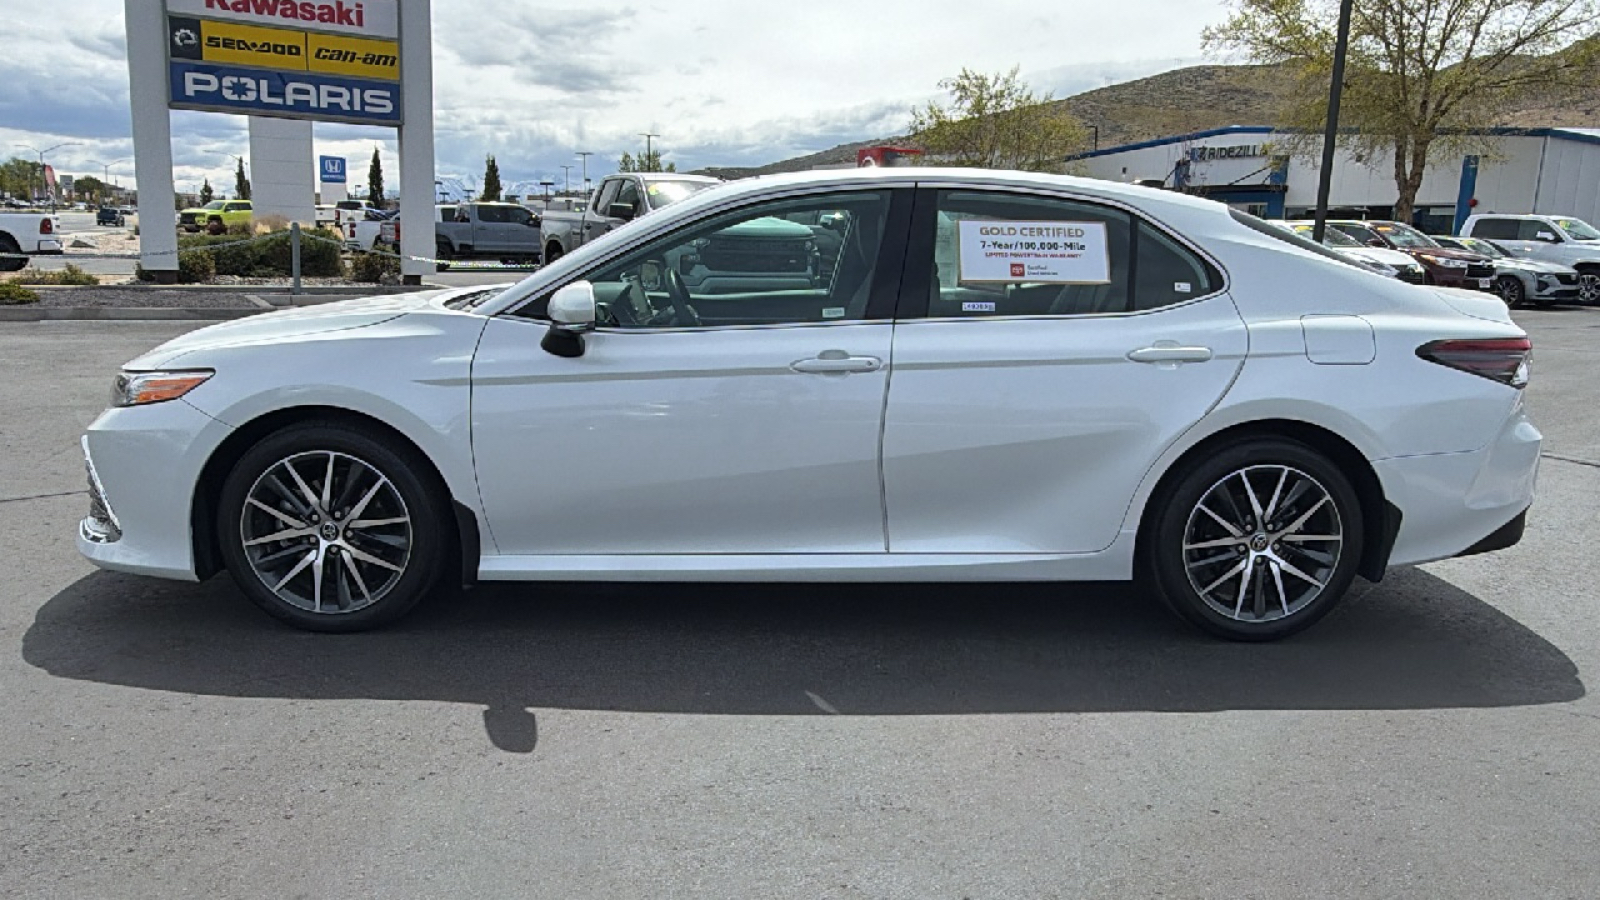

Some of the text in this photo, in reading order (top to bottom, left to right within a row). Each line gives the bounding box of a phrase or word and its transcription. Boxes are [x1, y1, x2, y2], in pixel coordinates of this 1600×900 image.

[184, 72, 393, 114] POLARIS
[979, 226, 1085, 238] GOLD CERTIFIED
[979, 240, 1086, 251] 7-Year/100,000-Mile
